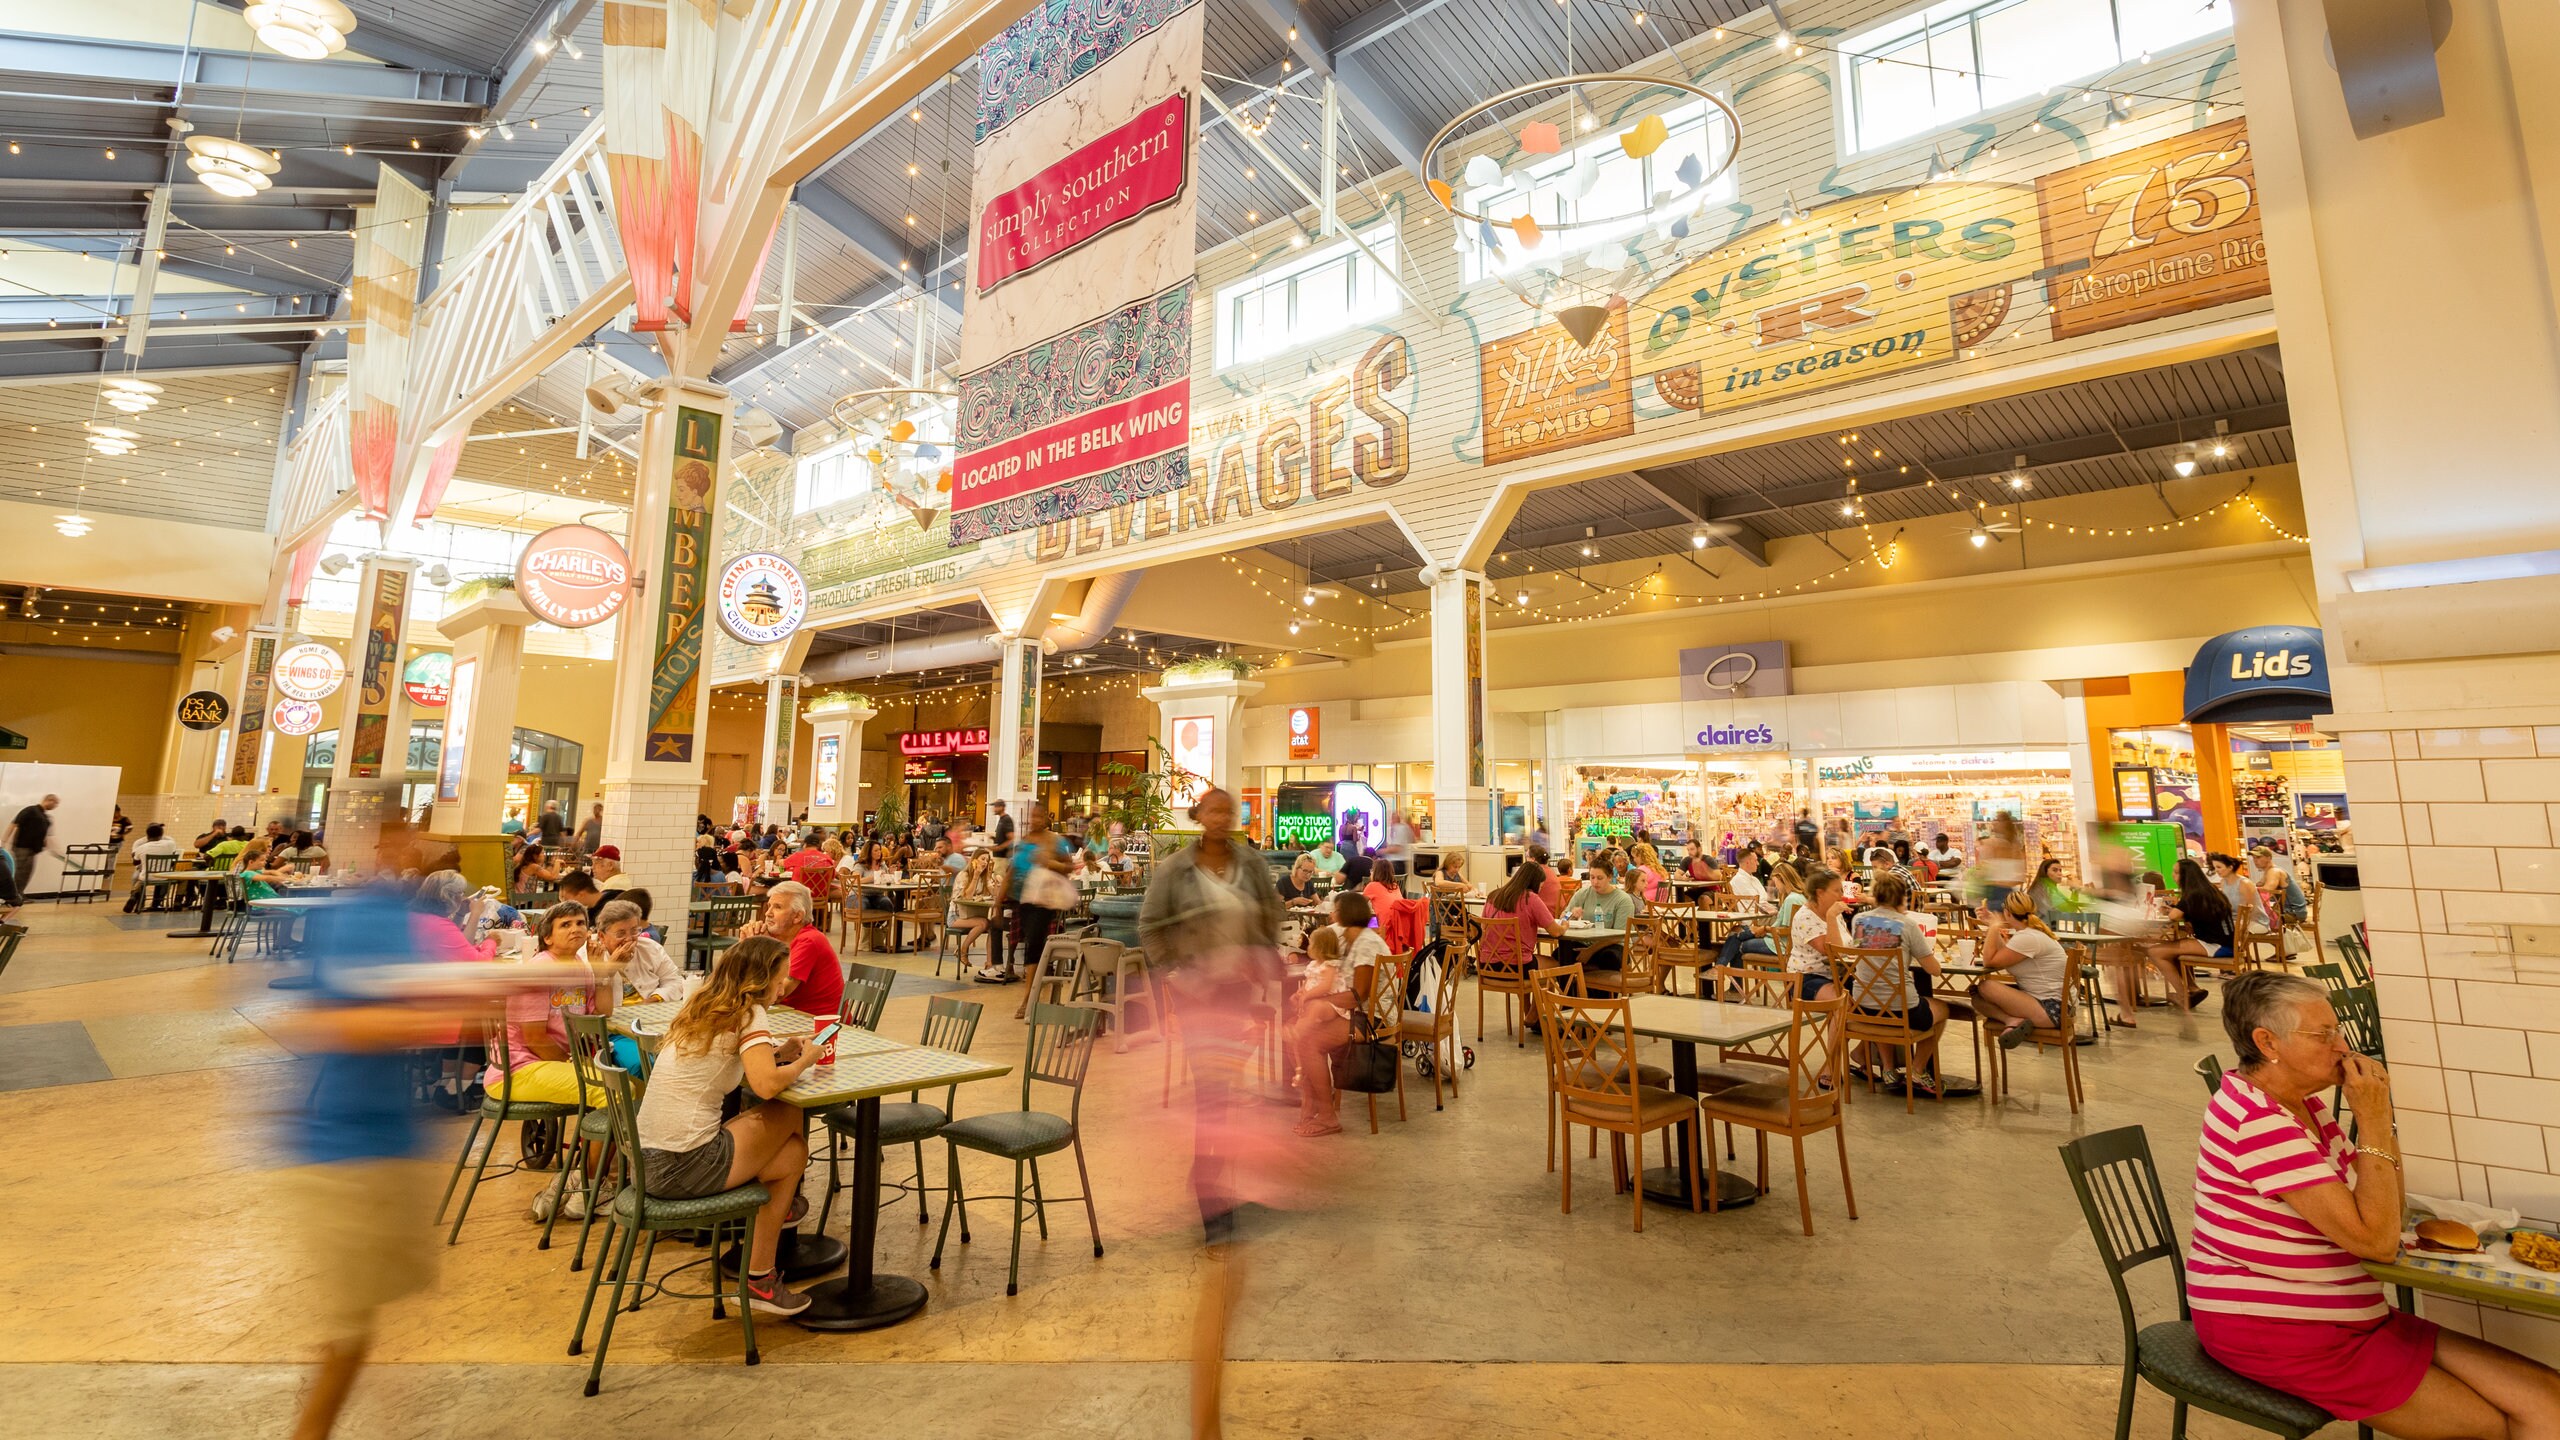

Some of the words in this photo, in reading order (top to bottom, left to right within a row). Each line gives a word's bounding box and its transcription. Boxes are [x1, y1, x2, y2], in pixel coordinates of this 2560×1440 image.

[985, 186, 1053, 247] simply
[1061, 129, 1169, 206] southern
[2083, 140, 2251, 258] 75
[1007, 186, 1131, 260] COLLECTION
[1648, 217, 2016, 353] OYSTERS
[2069, 252, 2214, 307] Aeroplane
[1723, 366, 1763, 393] in
[1770, 329, 1926, 383] season
[1533, 396, 1563, 416] and
[1502, 404, 1611, 449] KOMBO
[961, 456, 1021, 491] LOCATED
[1026, 450, 1042, 473] IN
[1046, 440, 1075, 468] THE
[1080, 420, 1123, 454] BELK
[1128, 401, 1183, 438] WING
[526, 551, 627, 585] CHARLEYS
[804, 547, 850, 580] Myrtle
[851, 539, 899, 574] Beach
[722, 559, 754, 599] CHINA
[758, 557, 803, 606] EXPRESS
[814, 585, 861, 609] PRODUCE
[863, 581, 872, 599] &
[874, 573, 911, 597] FRESH
[914, 561, 956, 588] FRUITS
[525, 579, 568, 620] PHILLY
[570, 591, 623, 622] STEAKS
[727, 610, 768, 639] Chinese
[771, 615, 797, 637] Food
[298, 646, 318, 654] HOME
[320, 647, 330, 656] OF
[382, 643, 394, 658] 2
[2231, 649, 2313, 681] Lids
[288, 665, 318, 679] WINGS
[364, 670, 389, 706] S
[281, 680, 291, 691] THE
[309, 683, 336, 698] FLAVORS
[181, 708, 222, 721] BANK
[244, 713, 260, 730] 5
[2295, 723, 2311, 734] EXIT
[1291, 734, 1309, 746] at&t
[1697, 723, 1773, 746] claire's
[2312, 740, 2325, 748] EXIT
[2250, 756, 2270, 765] Lids
[1278, 816, 1302, 826] PHOTO
[1304, 816, 1332, 826] STUDIO
